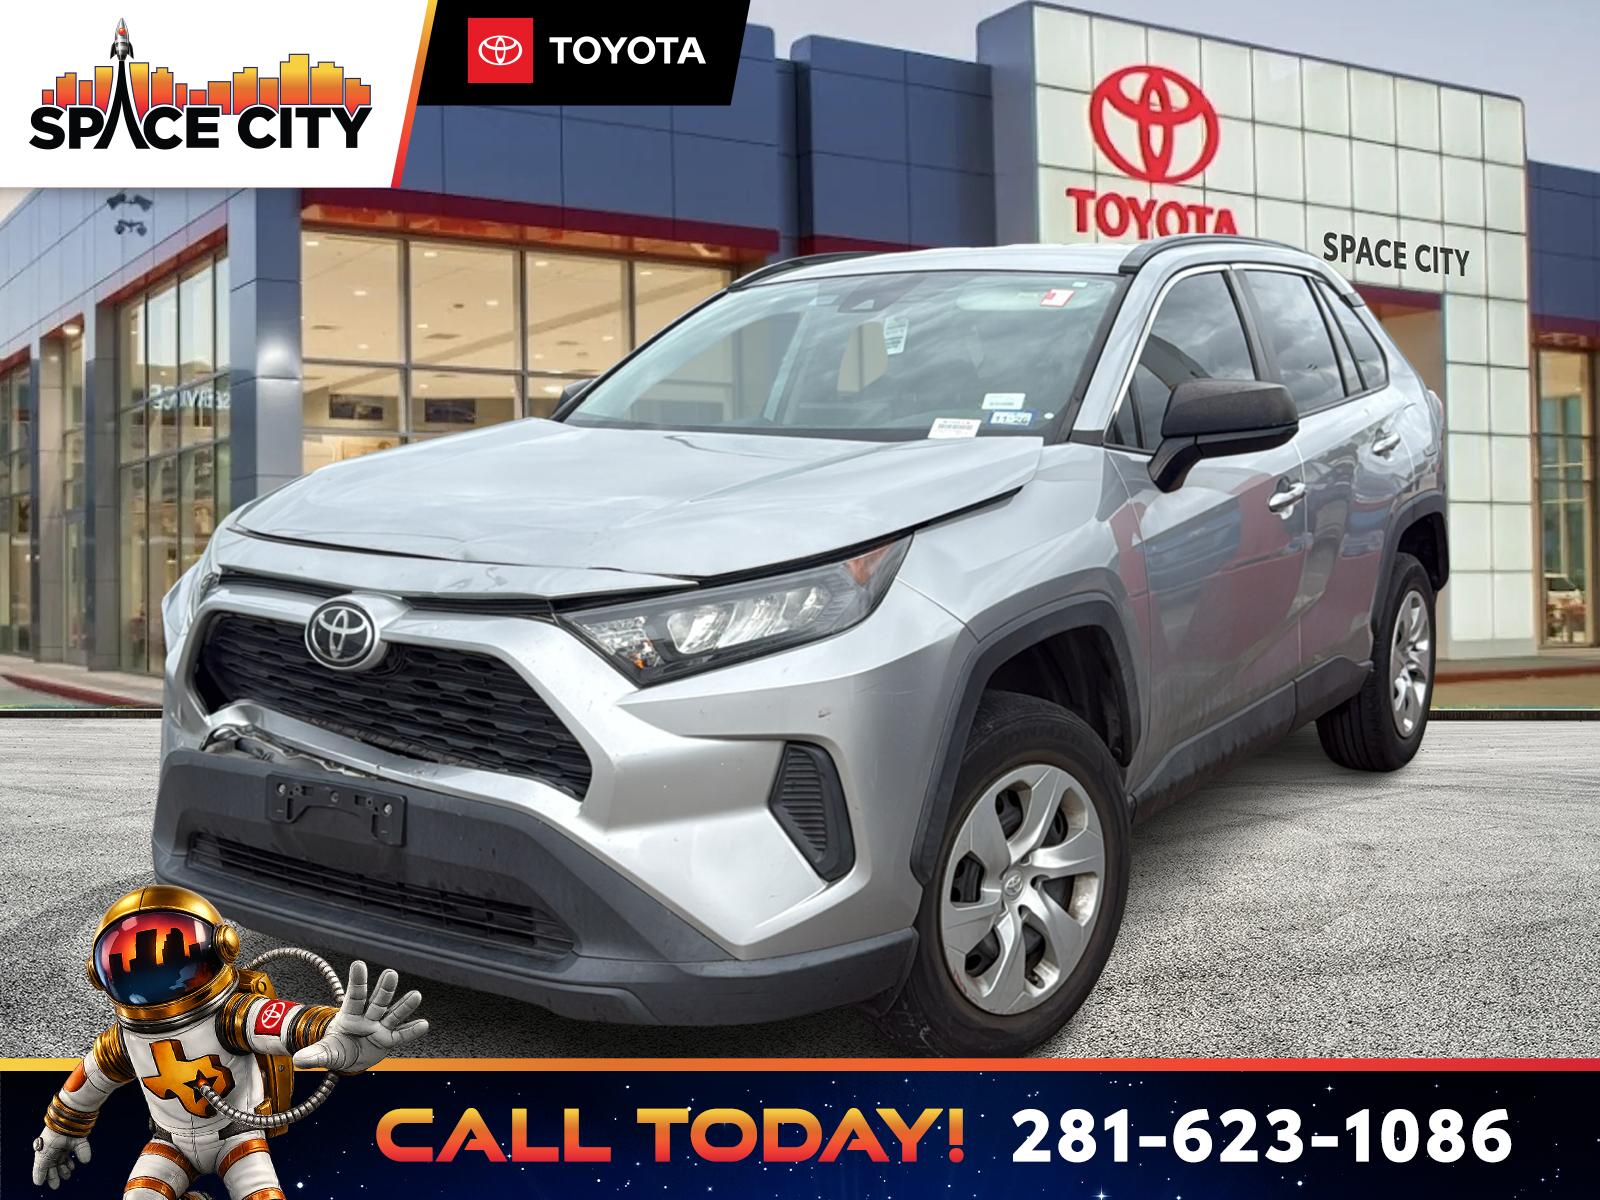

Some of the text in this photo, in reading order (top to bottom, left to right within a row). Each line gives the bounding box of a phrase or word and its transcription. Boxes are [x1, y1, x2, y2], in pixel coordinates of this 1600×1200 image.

[1065, 187, 1238, 240] TOYOTA
[1323, 231, 1470, 277] SPACE CITY
